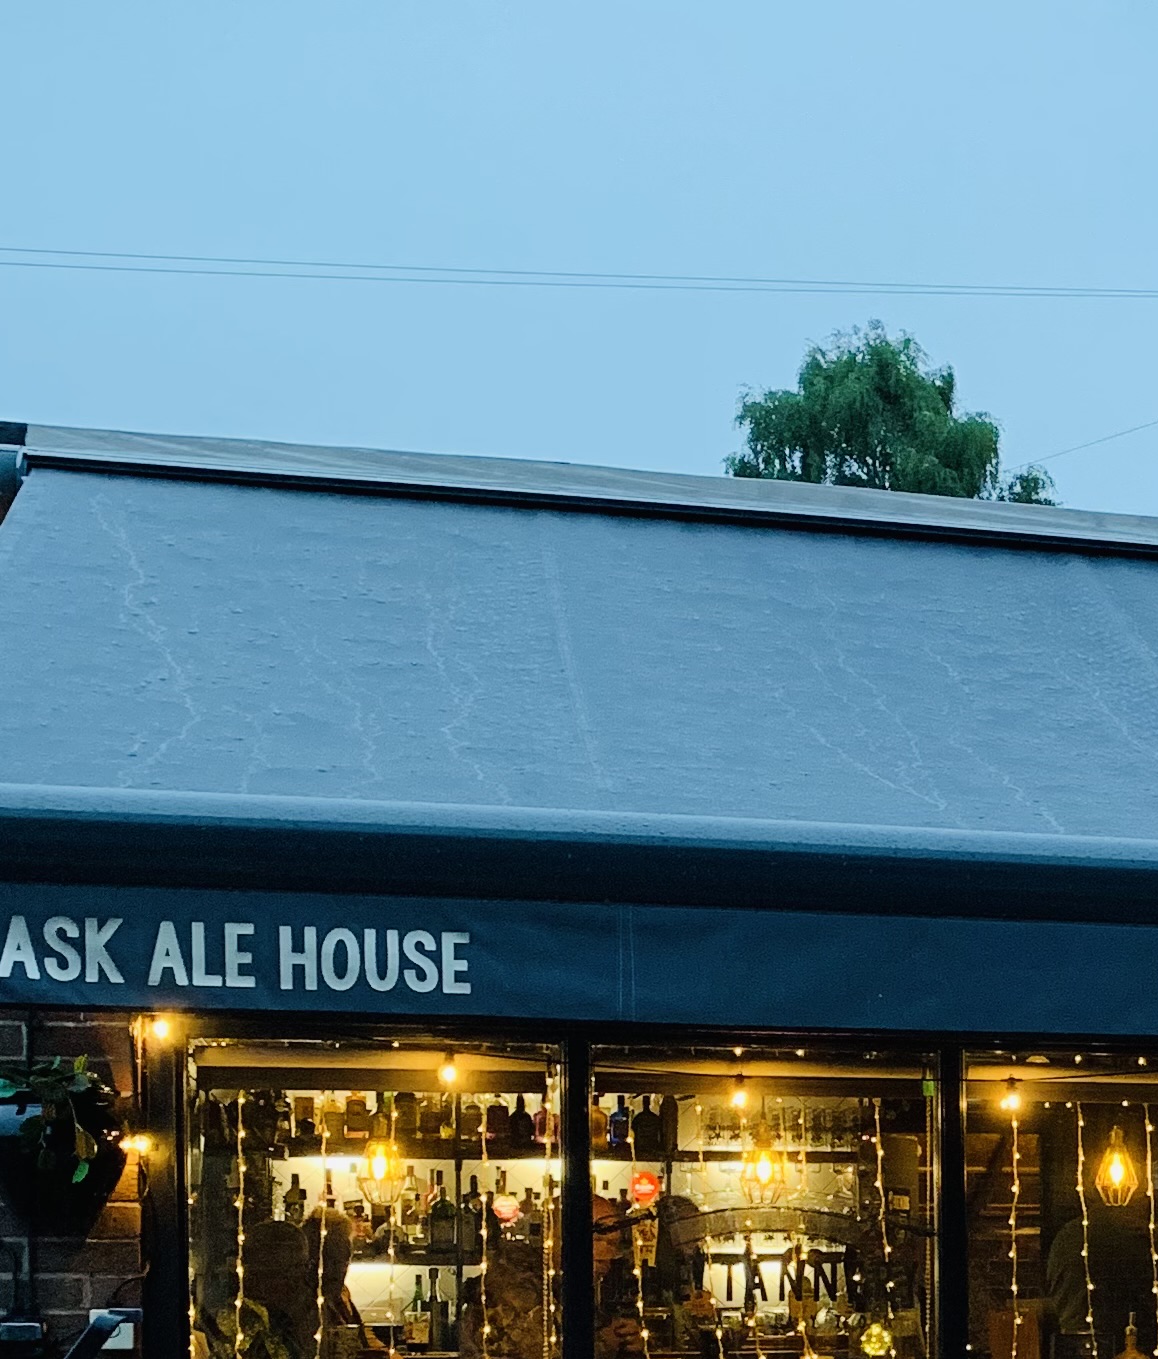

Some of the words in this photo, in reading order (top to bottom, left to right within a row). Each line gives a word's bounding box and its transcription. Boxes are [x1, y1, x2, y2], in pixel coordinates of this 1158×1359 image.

[0, 915, 125, 984] ASK
[147, 920, 257, 988] ALE
[278, 925, 472, 995] HOUSE
[718, 1256, 839, 1302] TANN
